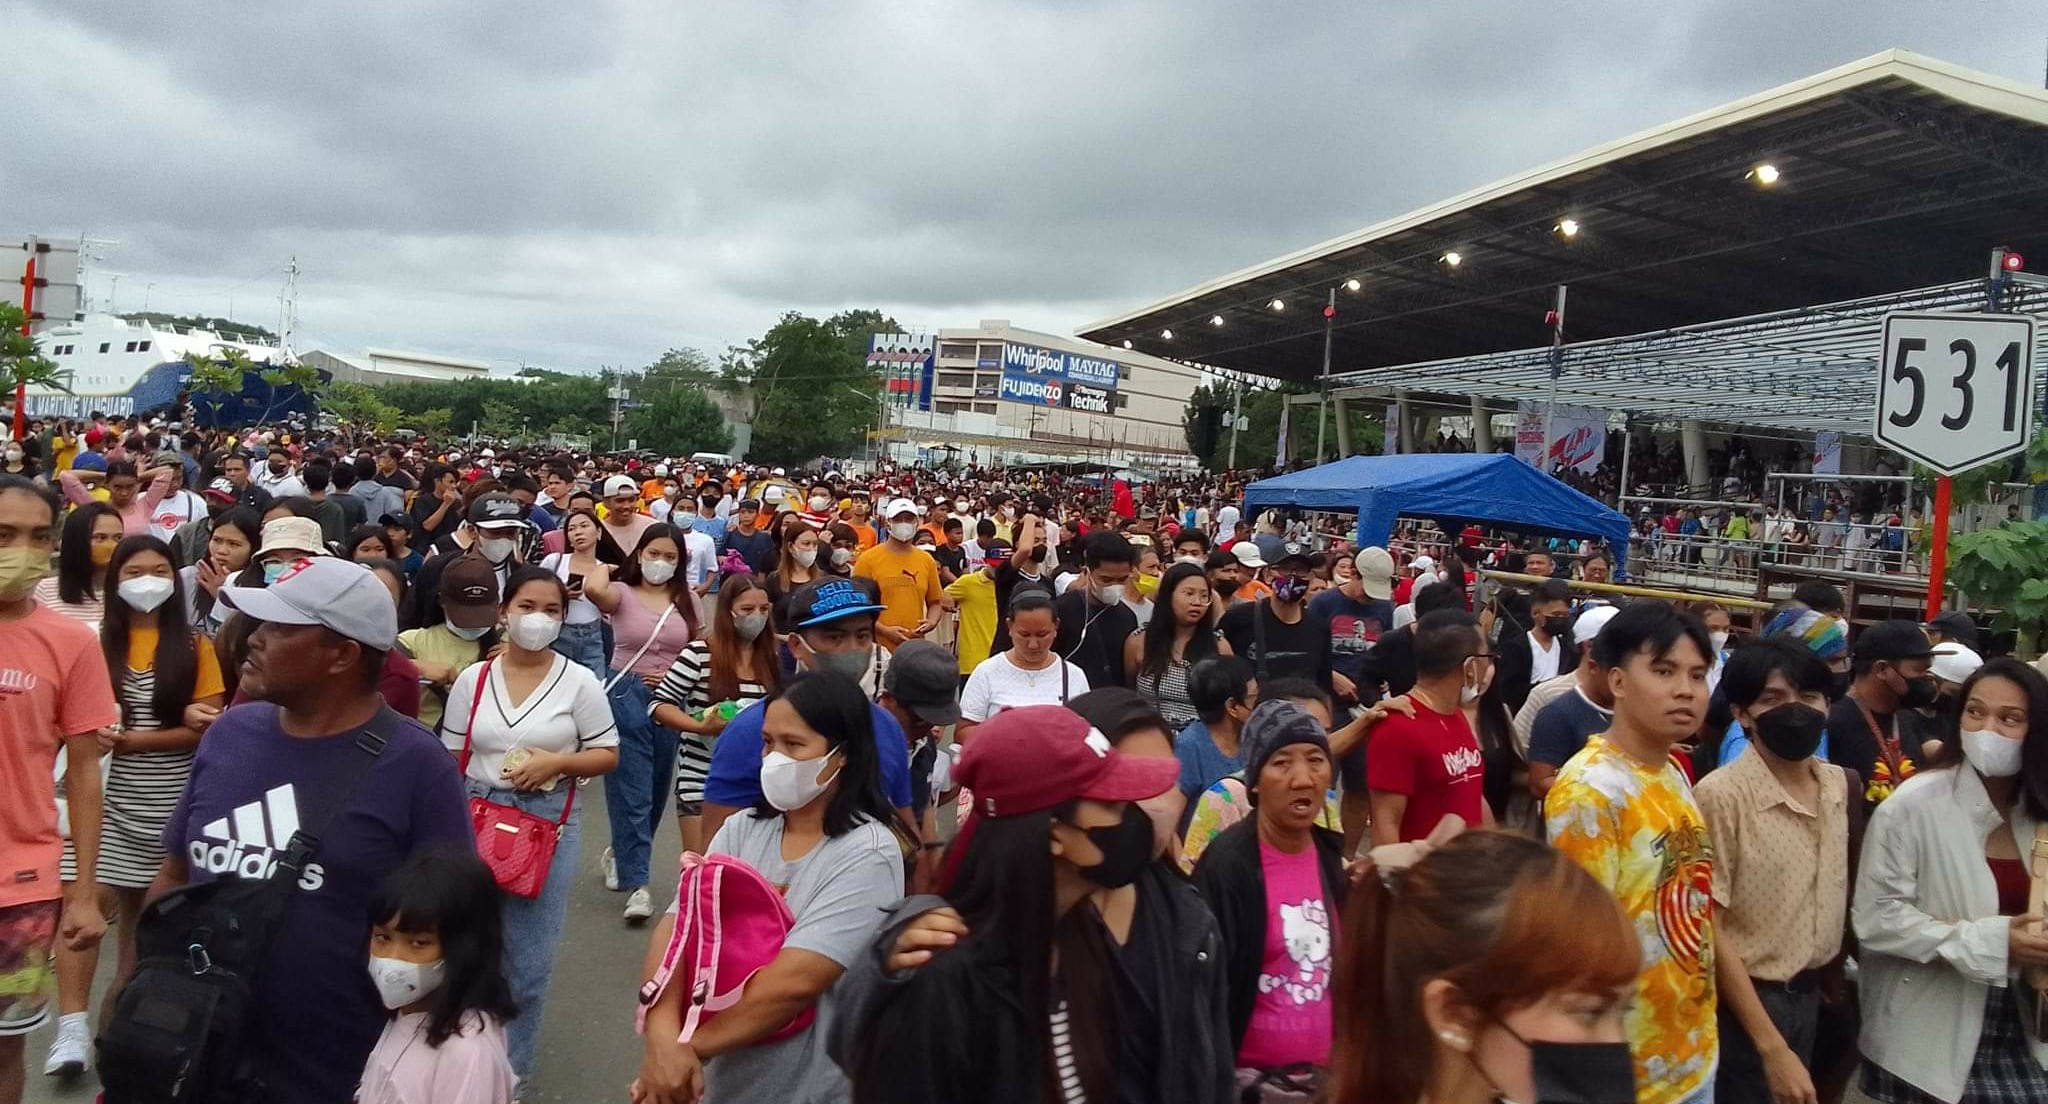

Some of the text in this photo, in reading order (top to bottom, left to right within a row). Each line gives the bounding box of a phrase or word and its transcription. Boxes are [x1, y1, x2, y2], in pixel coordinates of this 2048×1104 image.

[1006, 344, 1064, 374] Whirlpool
[1069, 356, 1116, 378] MAYTAG
[1003, 378, 1061, 400] FUJIDENZO
[1888, 338, 2021, 431] 531
[37, 396, 79, 417] MARITIME
[82, 396, 134, 419] VANGUARD
[1069, 392, 1108, 413] Technik
[816, 581, 854, 600] HELLO
[811, 592, 868, 614] BROOKLYN
